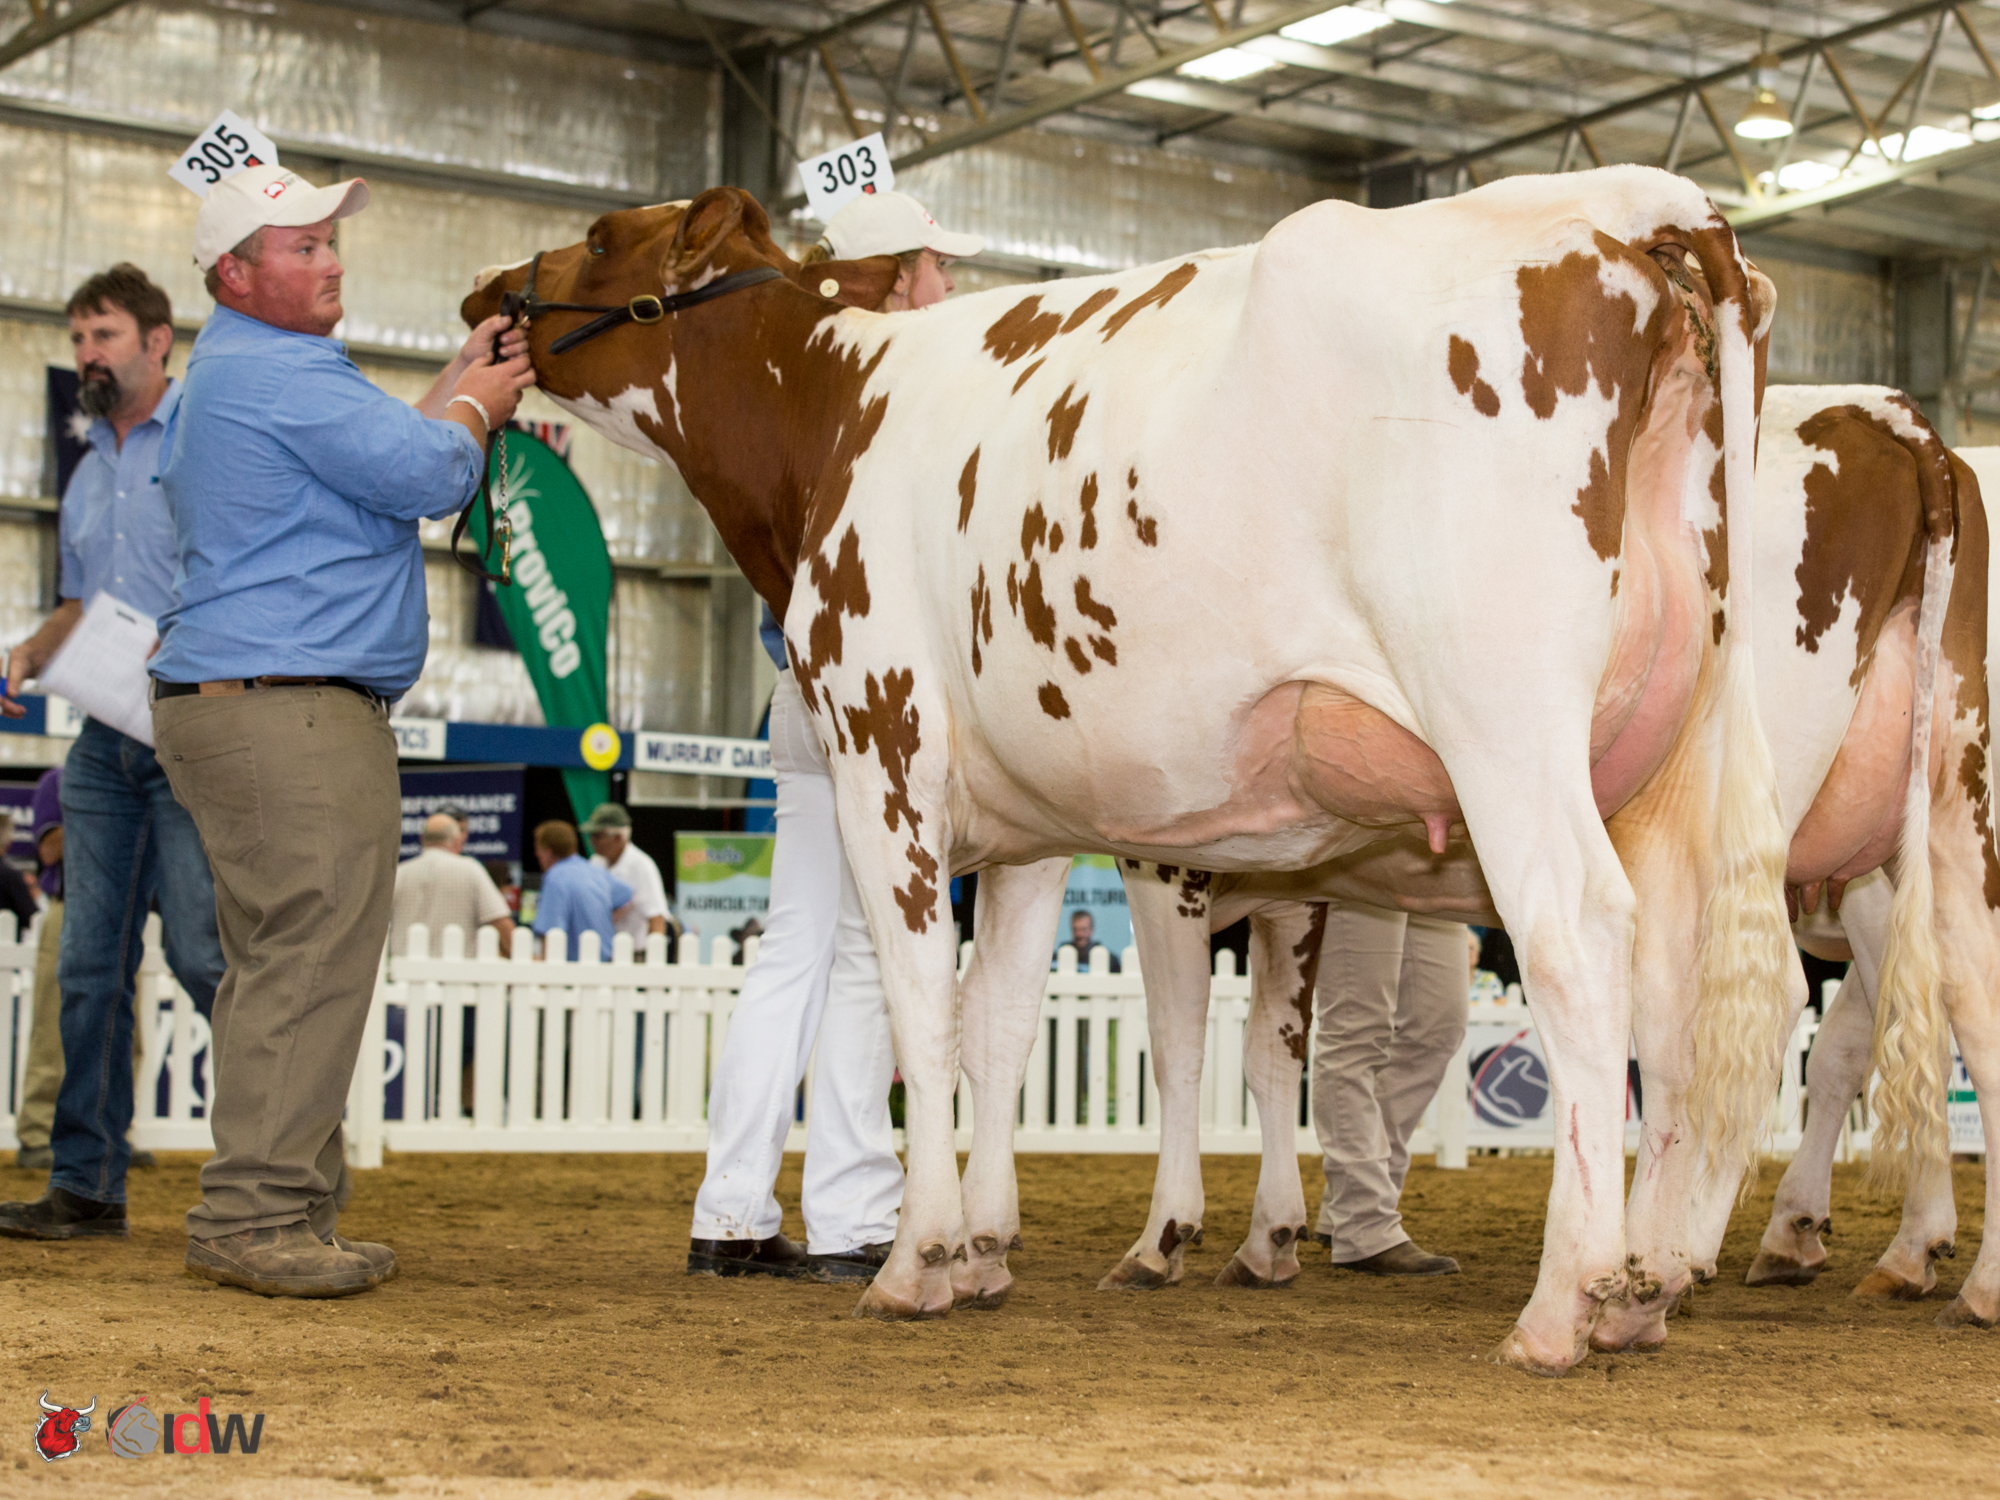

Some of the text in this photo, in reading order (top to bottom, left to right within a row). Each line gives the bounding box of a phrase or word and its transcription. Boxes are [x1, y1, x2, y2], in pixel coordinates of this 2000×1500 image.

[187, 124, 249, 184] 305
[818, 146, 877, 194] 303
[647, 740, 724, 763] MURRAY
